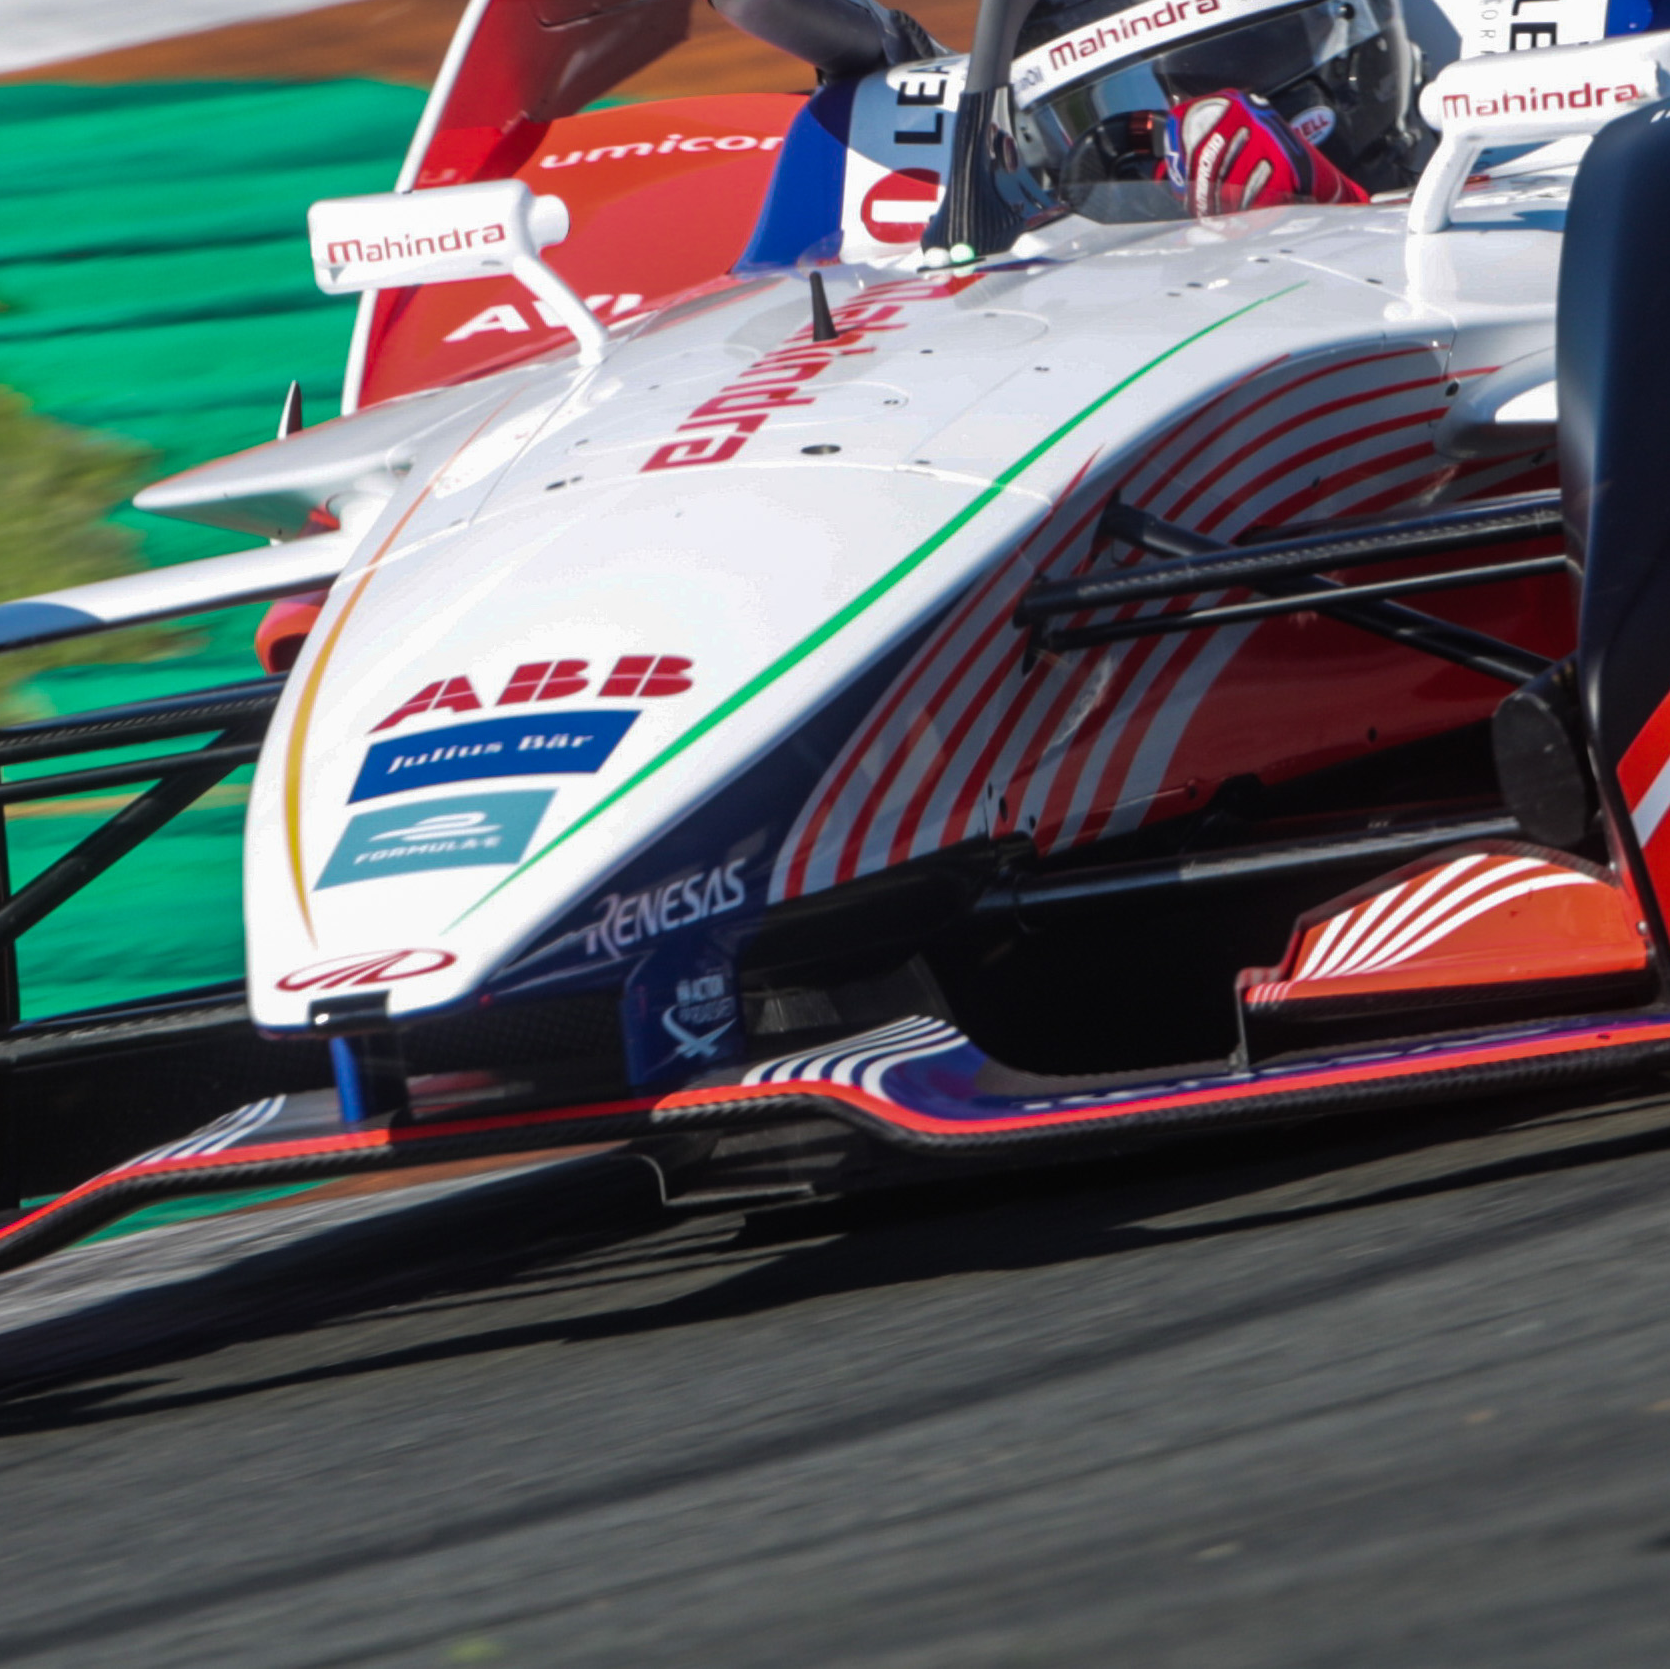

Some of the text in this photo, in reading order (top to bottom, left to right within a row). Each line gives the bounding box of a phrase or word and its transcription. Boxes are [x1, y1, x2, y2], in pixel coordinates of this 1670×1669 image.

[893, 65, 950, 145] LEA
[1442, 81, 1640, 120] Mahindra
[540, 133, 784, 168] umicor
[327, 222, 506, 265] Mahindra
[367, 655, 694, 735] ABB
[386, 733, 594, 775] Julius Bär
[586, 857, 747, 961] RENESAS
